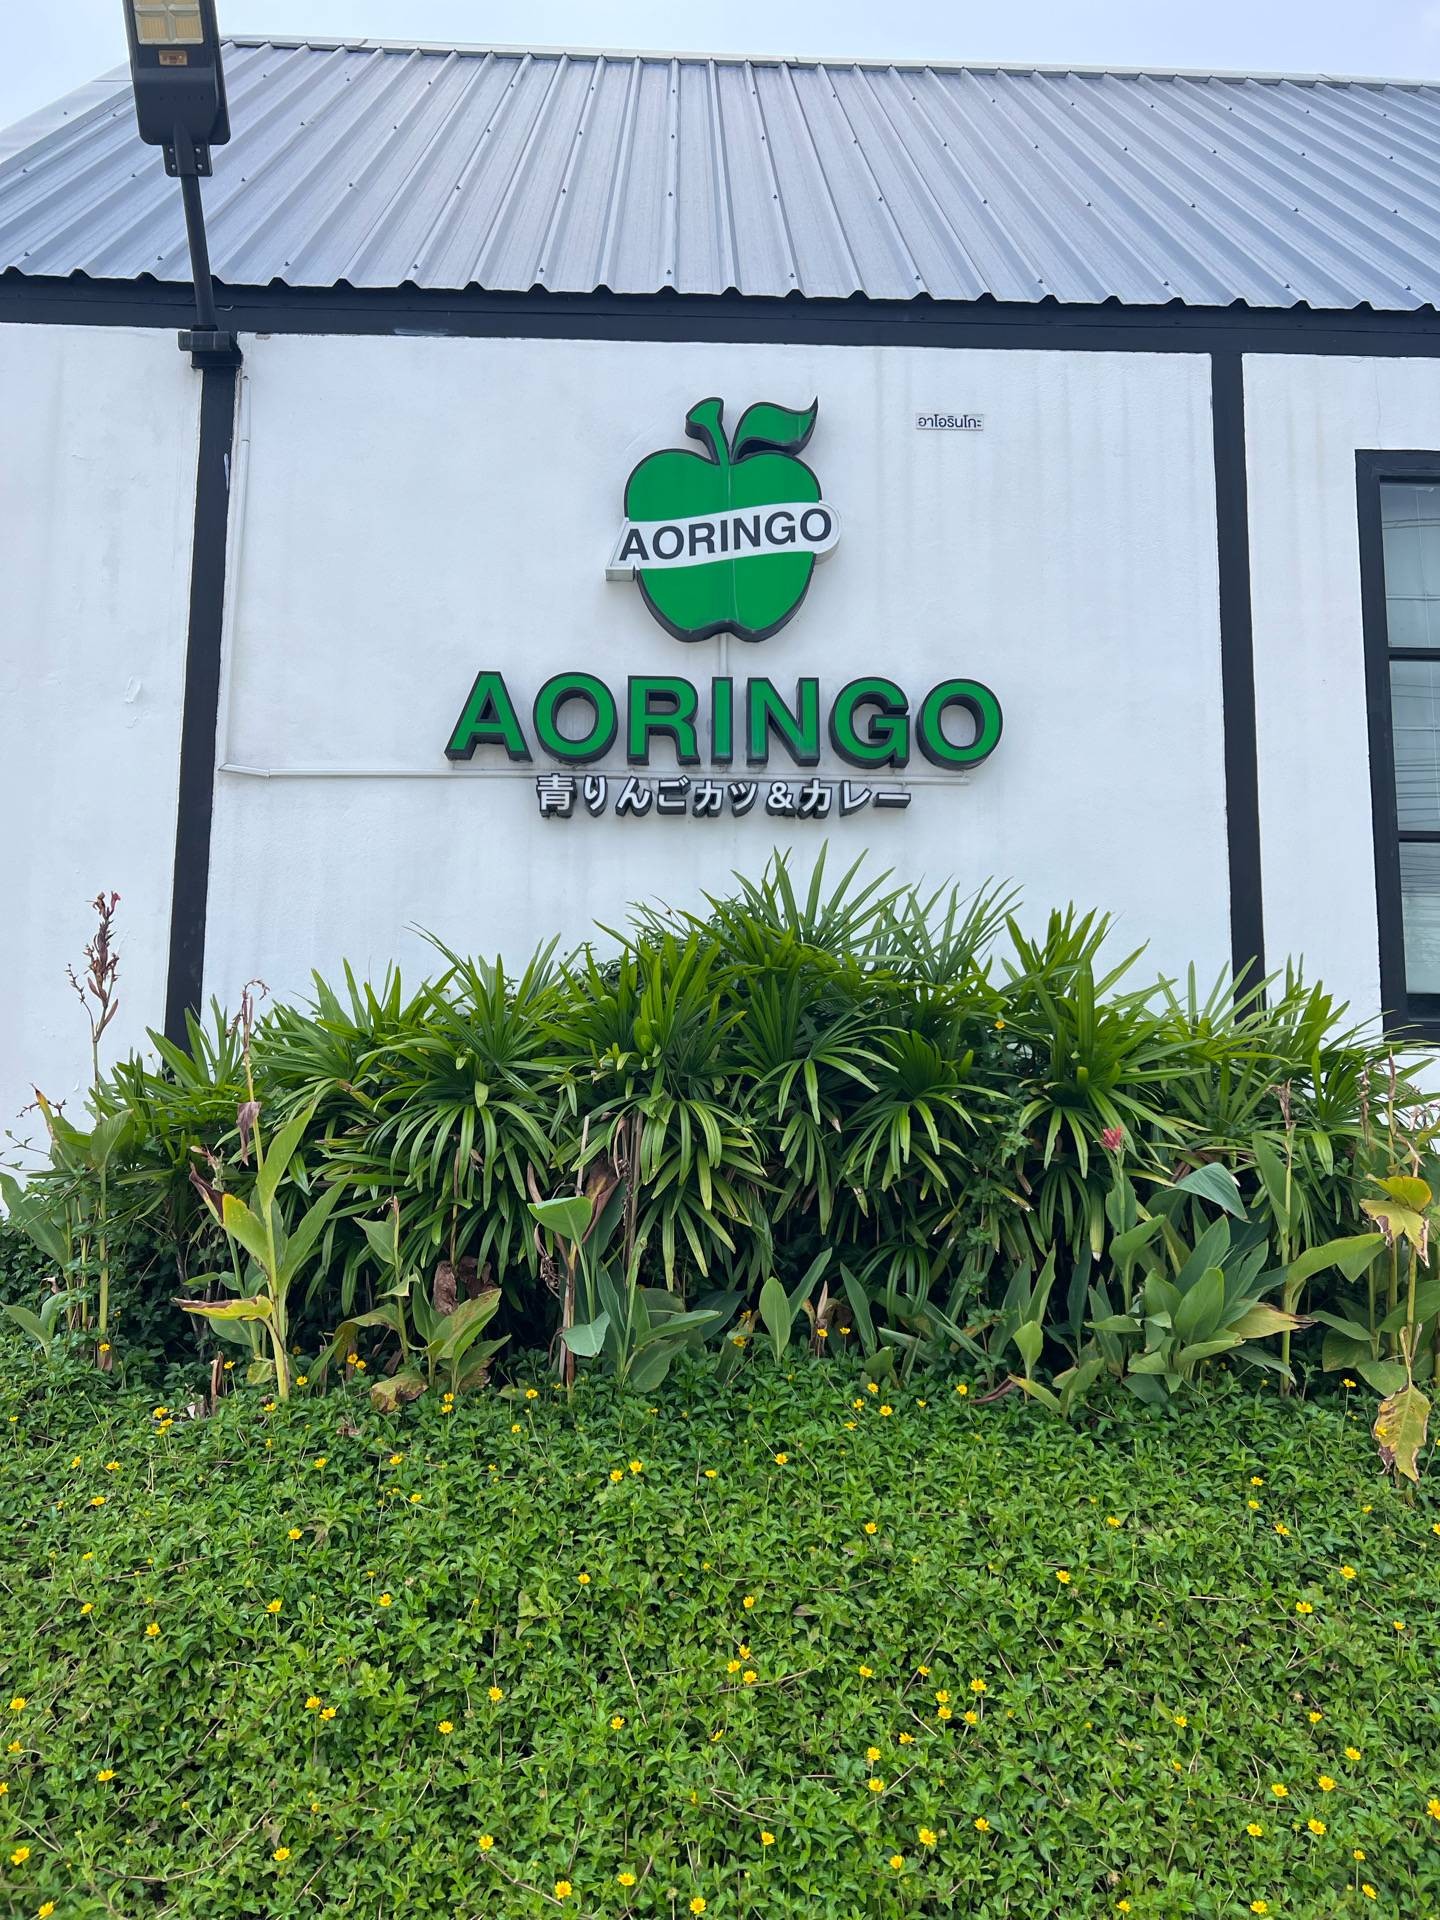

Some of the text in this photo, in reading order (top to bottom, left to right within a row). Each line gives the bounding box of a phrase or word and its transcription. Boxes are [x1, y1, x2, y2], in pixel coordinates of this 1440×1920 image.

[918, 414, 982, 428] อาโอรินโกะ
[618, 508, 832, 562] AORINGO
[445, 671, 1003, 769] AORINGO
[536, 773, 911, 818] 青りんごカツ&カレー
